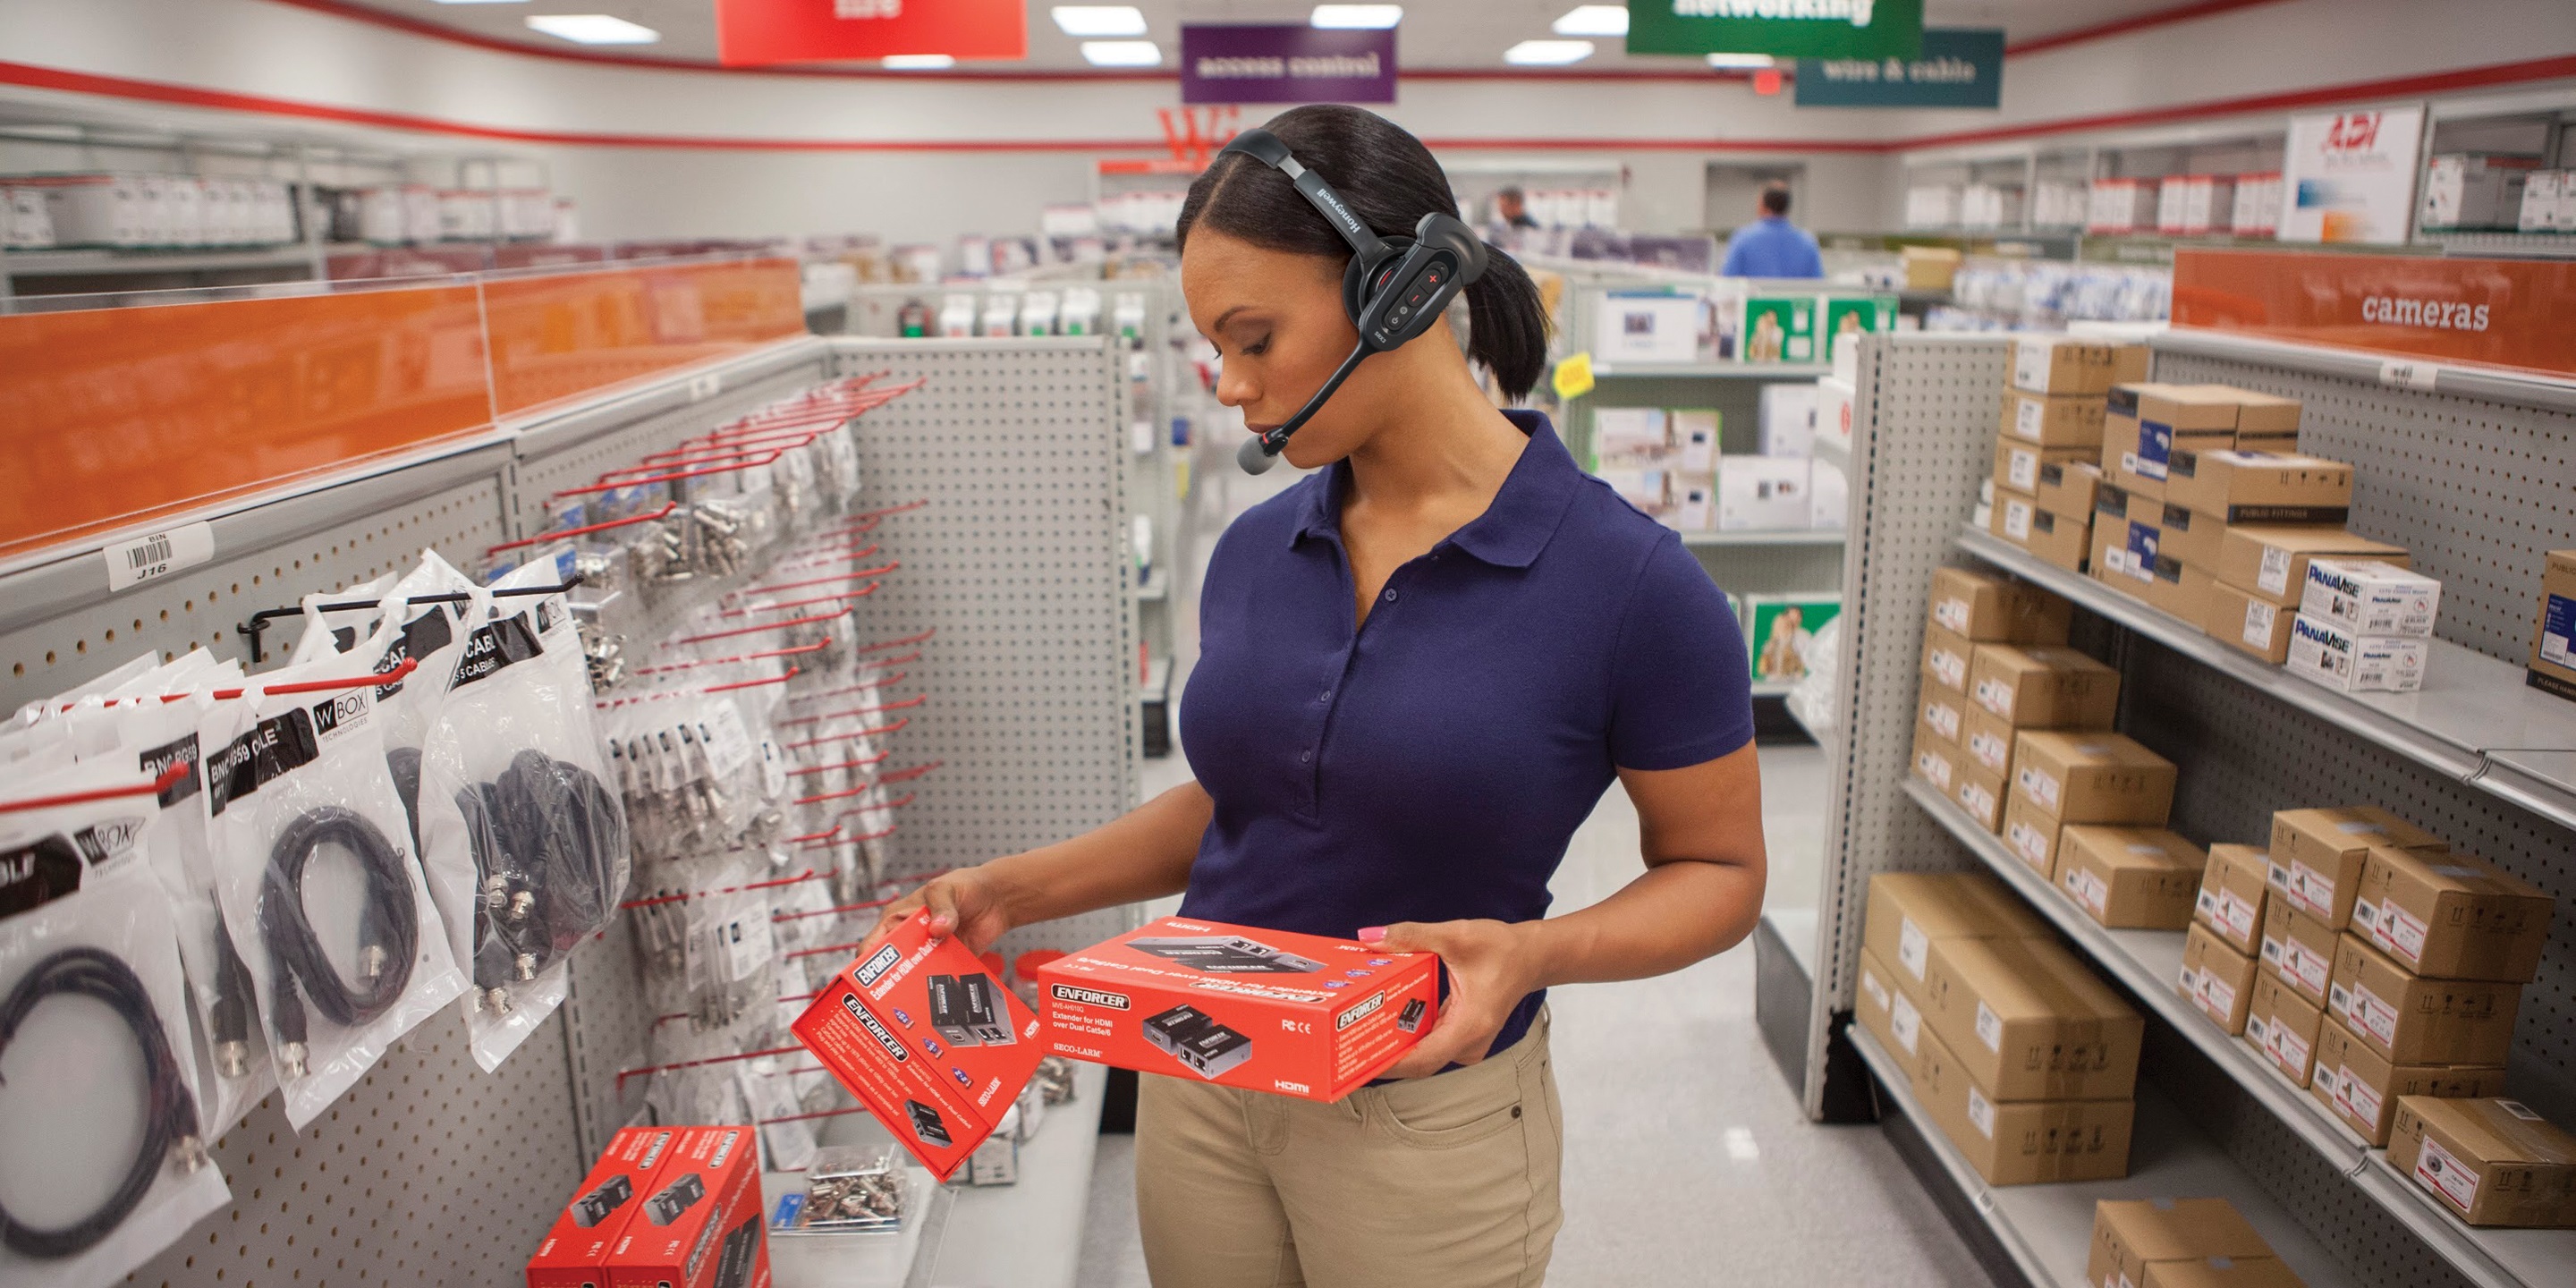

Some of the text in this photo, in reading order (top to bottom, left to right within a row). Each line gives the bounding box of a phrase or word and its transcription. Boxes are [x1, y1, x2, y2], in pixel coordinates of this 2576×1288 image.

[1317, 188, 1361, 234] Honeywell
[2361, 293, 2490, 333] cameras
[148, 533, 167, 543] BIN
[137, 563, 167, 580] J16
[322, 716, 369, 744] TECHNOLOGIES
[910, 950, 924, 965] over
[917, 940, 934, 957] Dual
[858, 946, 899, 987] ENFORCER
[889, 968, 902, 983] for
[895, 958, 915, 977] HDMI
[869, 975, 896, 1001] Extender
[1056, 987, 1124, 1008] ENFORCER
[1052, 1011, 1113, 1028] Extender for HDMI
[1339, 994, 1383, 1028] ENFORCER
[844, 997, 905, 1059] ENFORCER
[1053, 1021, 1112, 1037] over Dual Cat5e/6
[1054, 1043, 1101, 1057] SECO-LARM
[1275, 1080, 1309, 1094] HDMI
